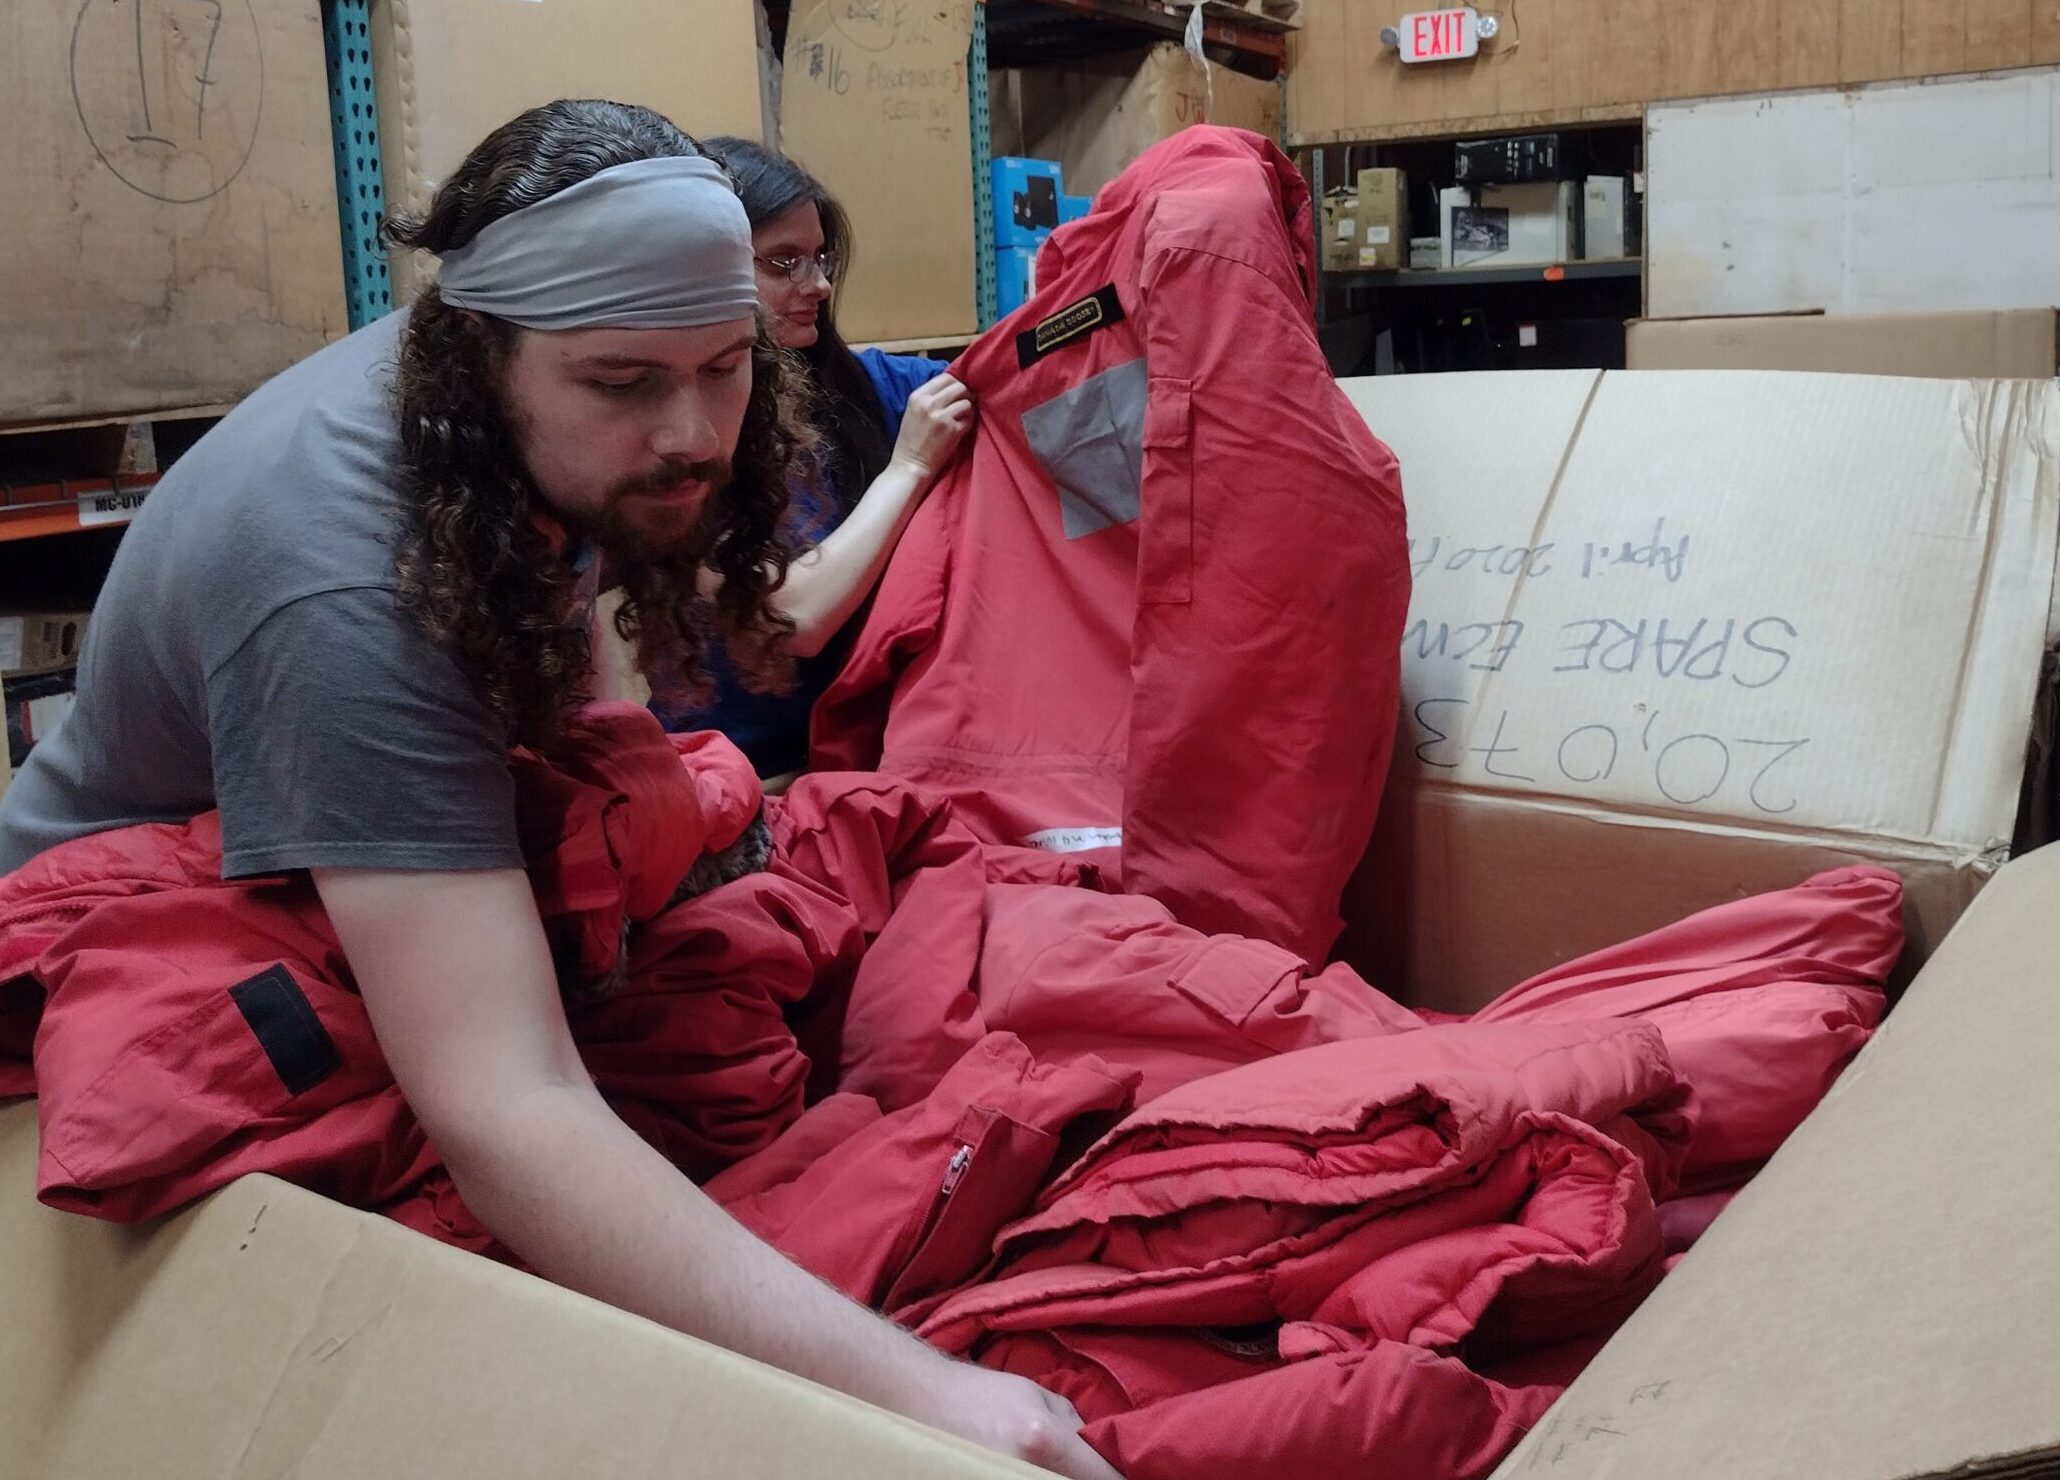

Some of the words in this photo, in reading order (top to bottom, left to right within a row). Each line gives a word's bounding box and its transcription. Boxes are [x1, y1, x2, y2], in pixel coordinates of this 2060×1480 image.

[1413, 12, 1466, 57] EXIT
[126, 0, 222, 148] 17
[1581, 516, 1691, 583] April
[1552, 616, 1798, 690] SPARE
